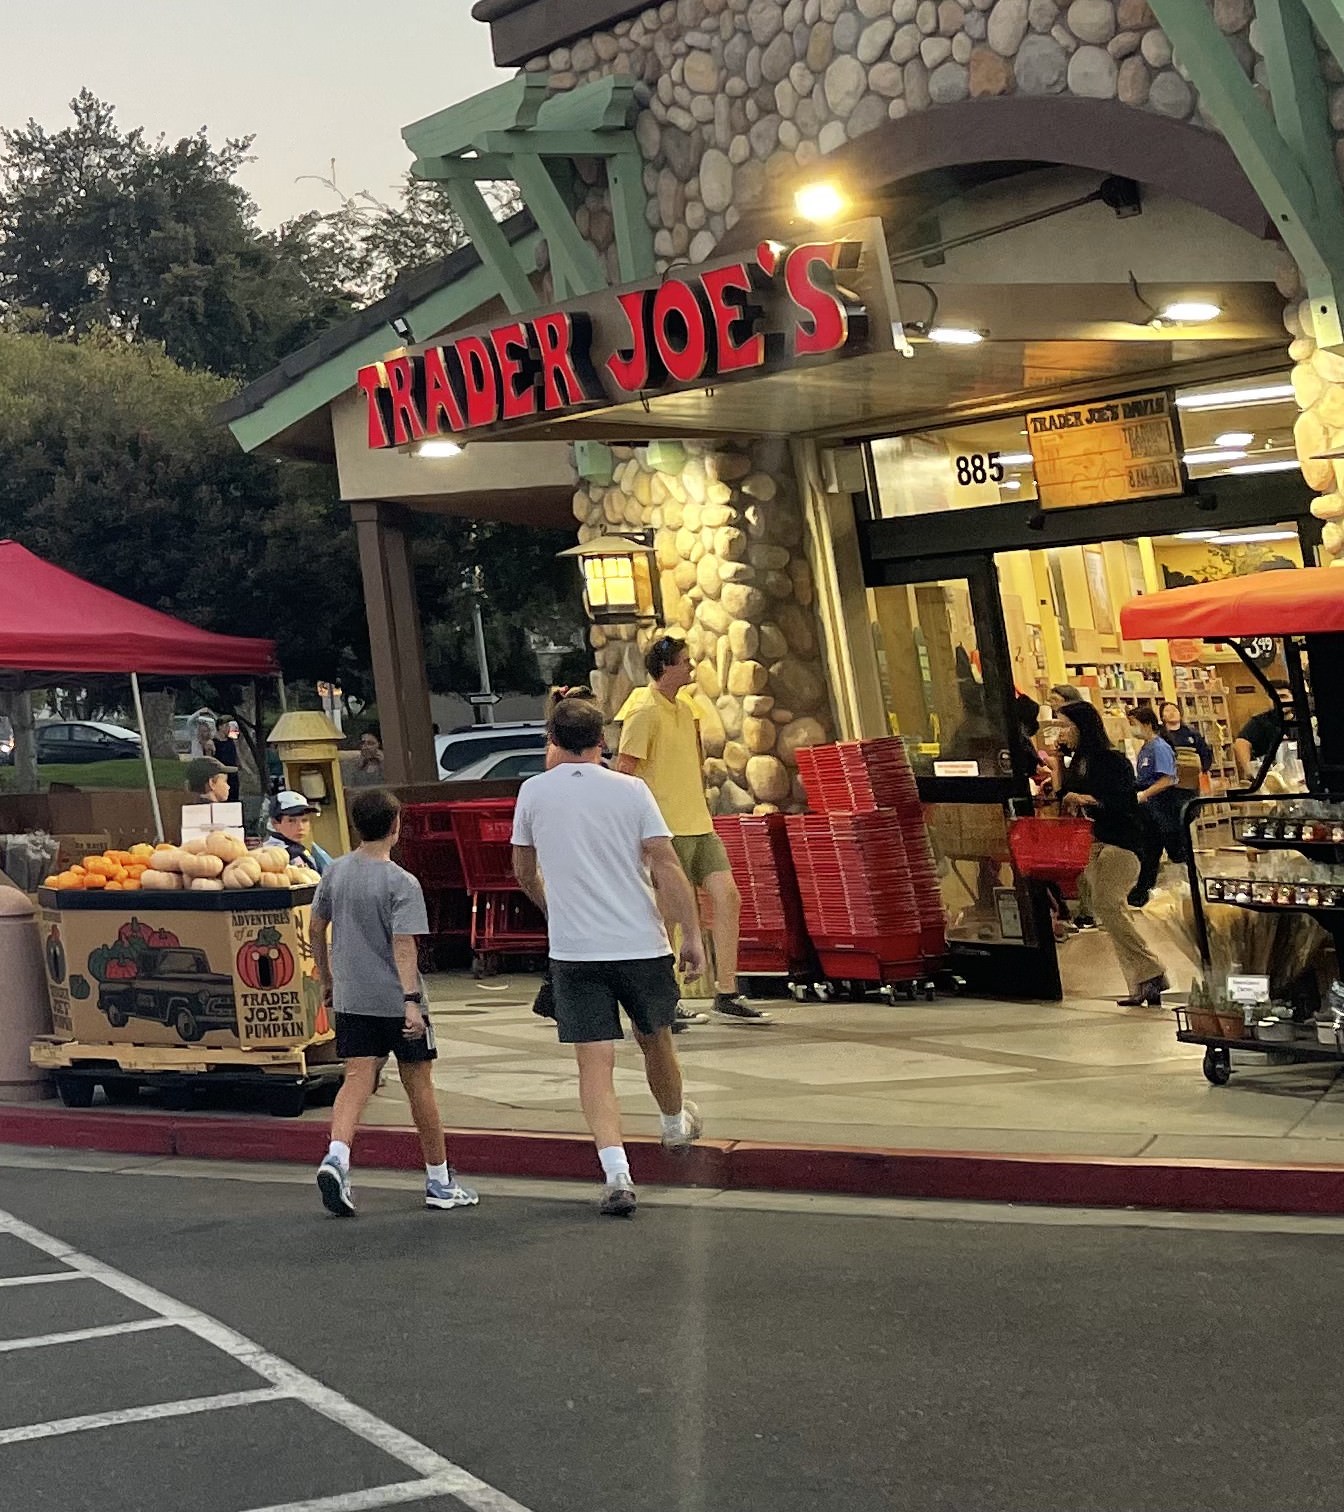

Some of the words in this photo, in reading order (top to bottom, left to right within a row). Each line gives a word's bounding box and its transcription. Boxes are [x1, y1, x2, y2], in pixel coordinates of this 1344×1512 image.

[357, 311, 586, 449] TRADER
[606, 239, 849, 392] JOE'S
[1030, 411, 1083, 433] TRADER
[956, 451, 1004, 486] 885
[232, 912, 290, 927] ADVENTURES
[241, 991, 300, 1006] TRADER
[244, 1006, 294, 1022] JOE'S
[245, 1021, 304, 1039] PUMPKIN
